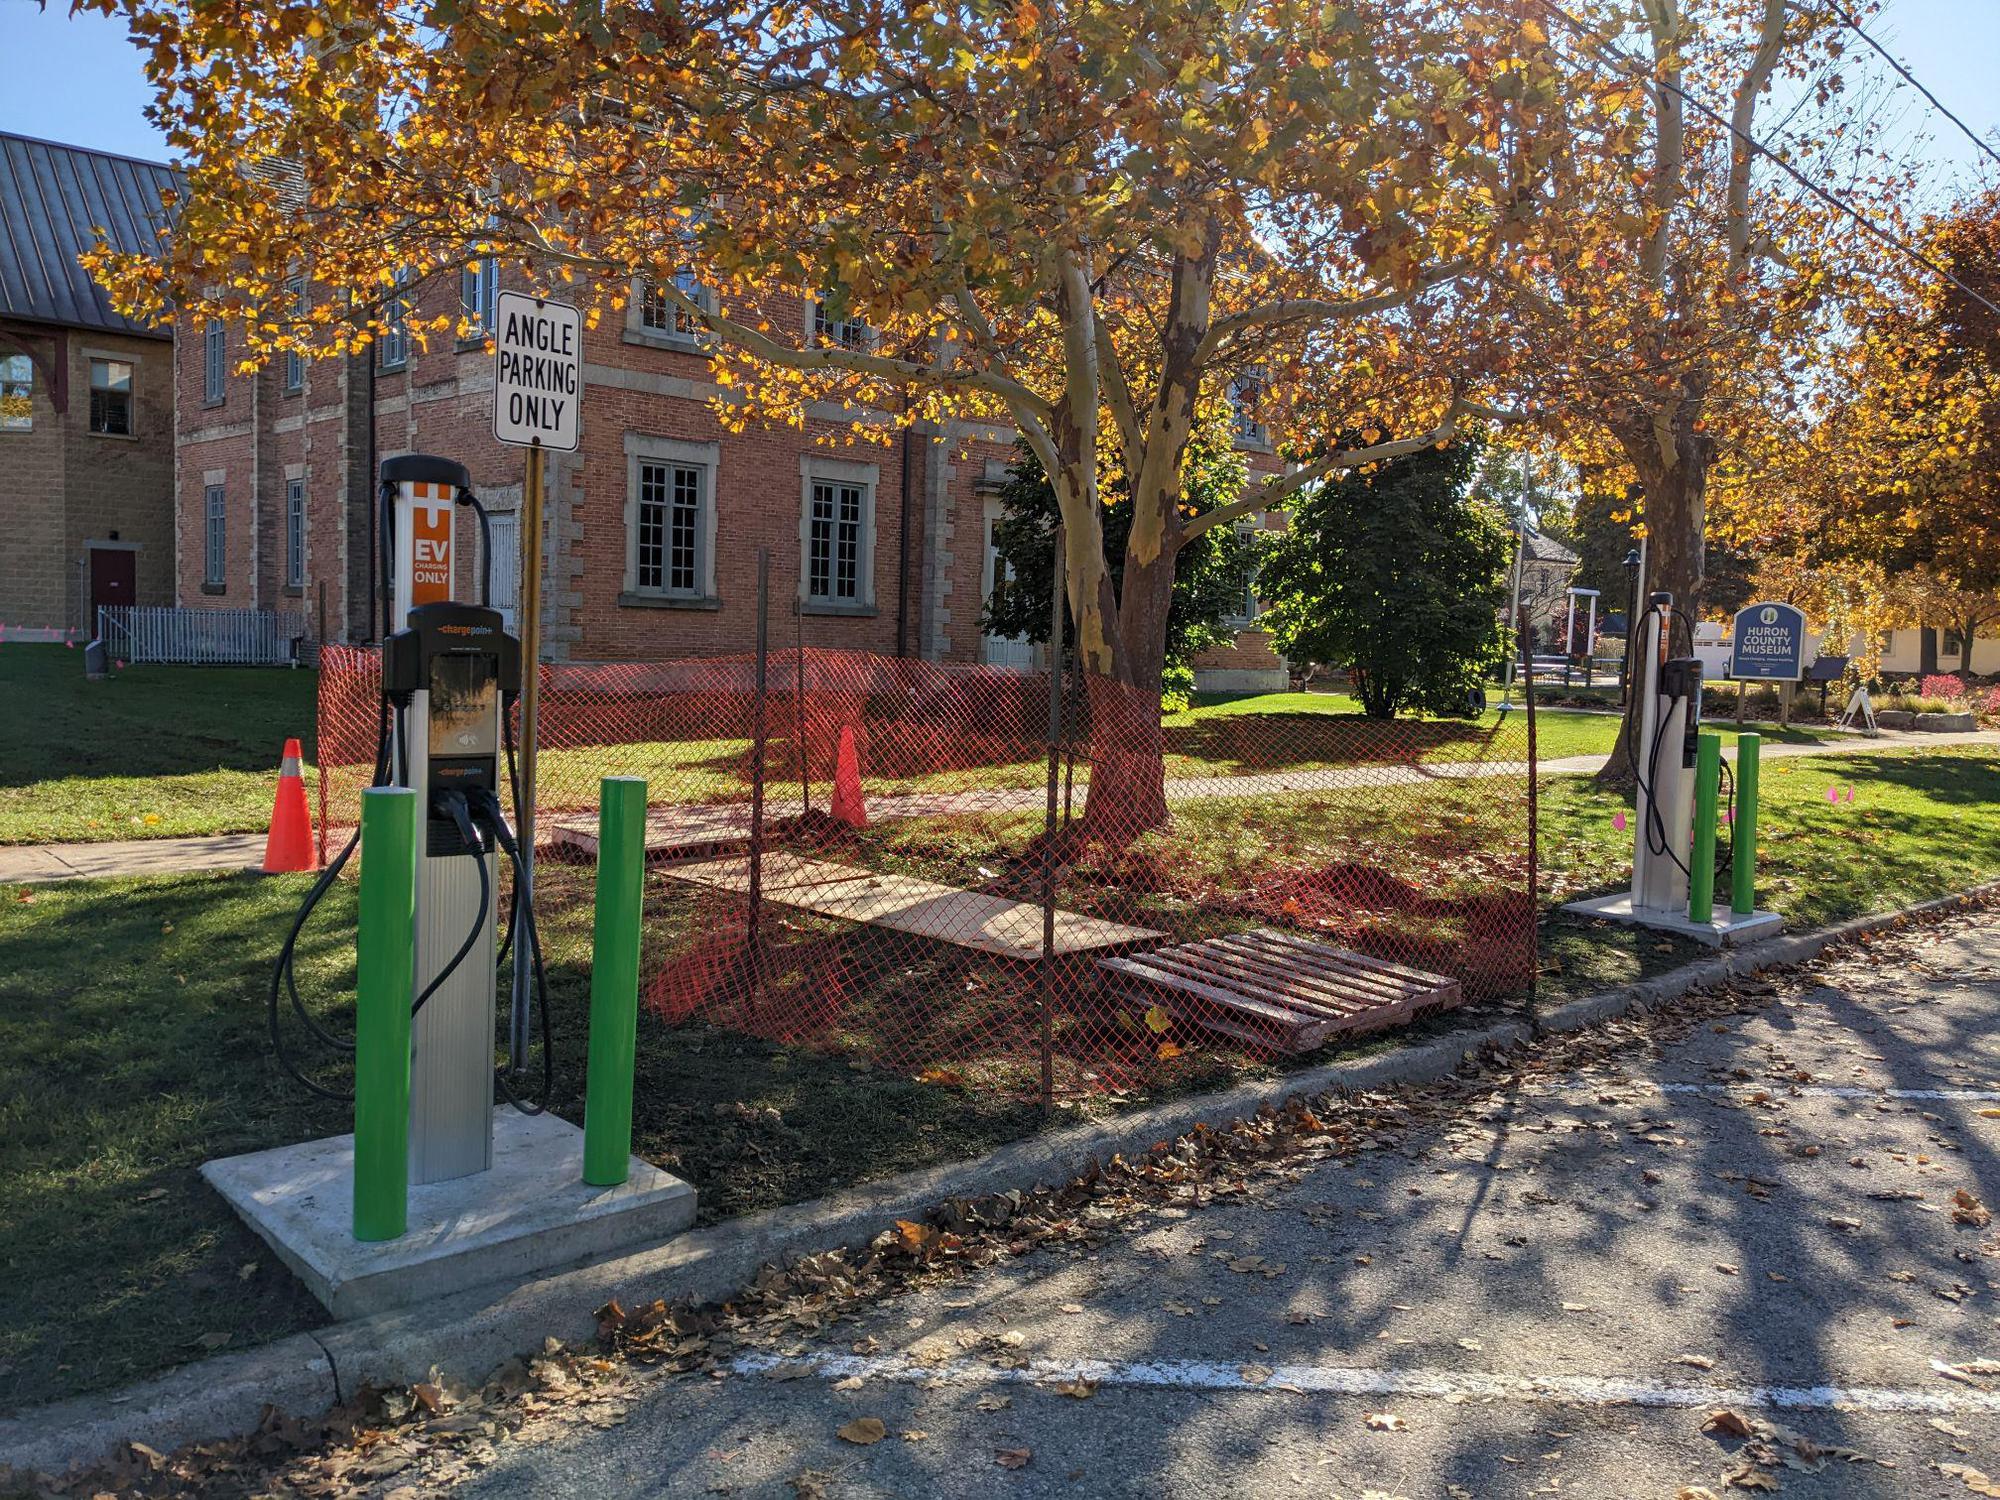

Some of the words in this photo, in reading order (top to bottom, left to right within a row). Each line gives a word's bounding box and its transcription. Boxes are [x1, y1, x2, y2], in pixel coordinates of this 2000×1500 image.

[505, 312, 573, 356] ANGLE
[500, 350, 576, 395] PARKING
[509, 392, 565, 431] ONLY
[415, 539, 448, 562] EV
[415, 562, 448, 571] CHARGING
[414, 571, 448, 584] ONLY
[1747, 627, 1789, 637] HURON
[1743, 636, 1792, 645] COUNTY
[1742, 645, 1792, 655] MUSEUM
